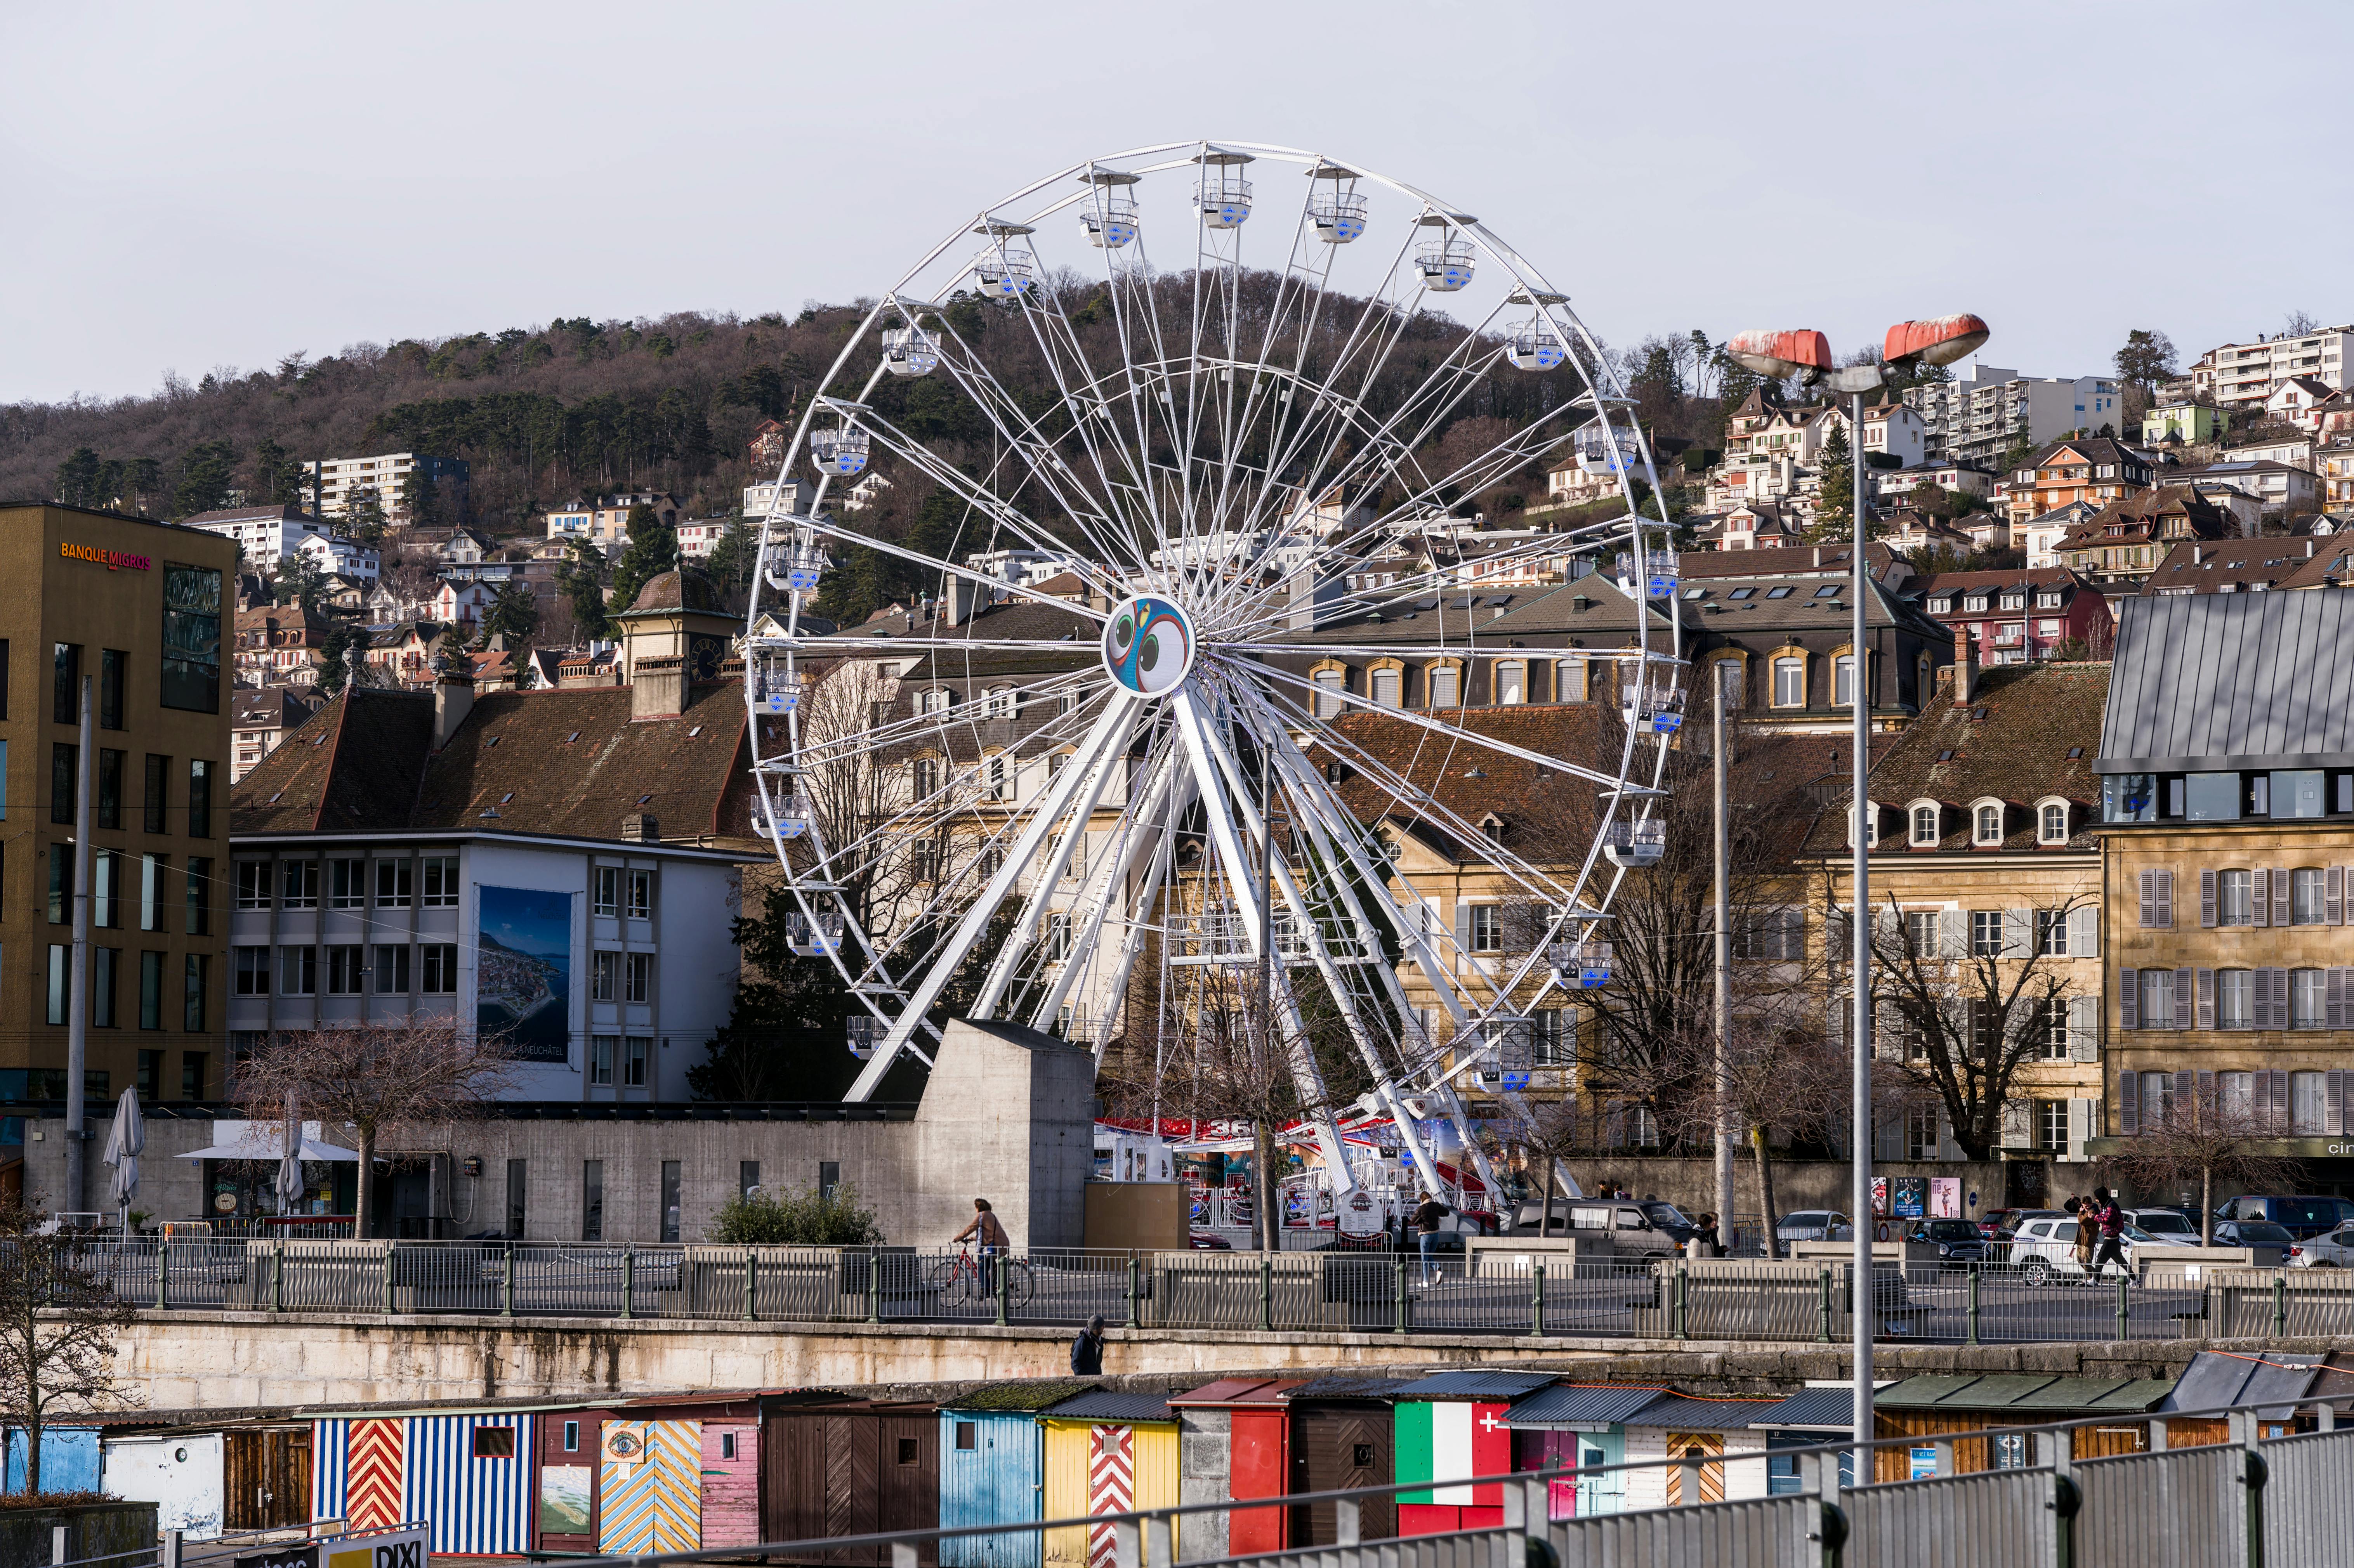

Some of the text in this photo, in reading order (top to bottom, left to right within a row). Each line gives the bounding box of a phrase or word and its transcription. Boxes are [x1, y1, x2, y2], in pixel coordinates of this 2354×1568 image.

[61, 542, 151, 570] BANQUE MIGROS
[525, 1044, 563, 1056] NEUCHÂTEL
[214, 1183, 222, 1192] Self
[1932, 1184, 1941, 1194] ne
[376, 1540, 421, 1568] DIXI
